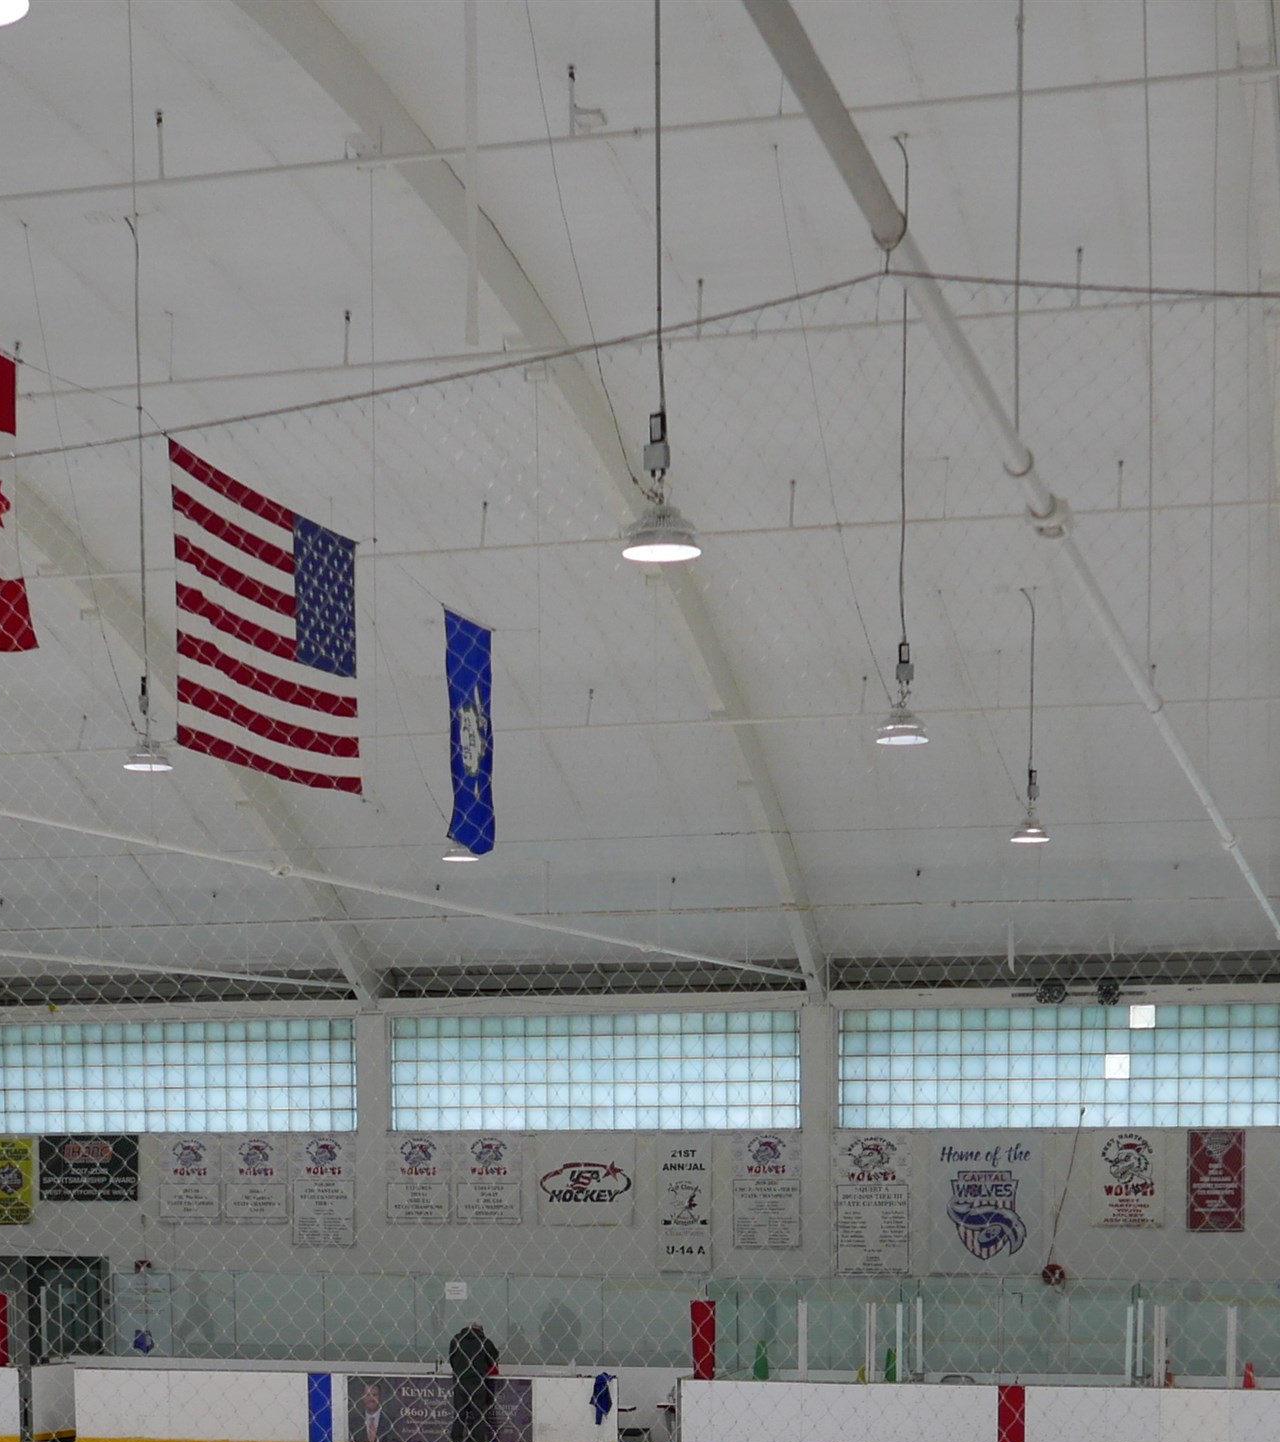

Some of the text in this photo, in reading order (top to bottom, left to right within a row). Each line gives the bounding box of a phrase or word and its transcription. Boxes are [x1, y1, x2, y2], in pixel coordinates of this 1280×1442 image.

[671, 1150, 697, 1158] 21ST
[940, 1143, 1031, 1168] Home of the
[746, 1164, 787, 1174] WOLVES
[42, 1176, 136, 1184] SPORTSMANSHIP AWARD
[962, 1174, 1007, 1182] CAPITAL
[548, 1188, 625, 1203] HOCKEY
[956, 1183, 1013, 1198] WOLVES
[666, 1245, 706, 1255] U-14 A
